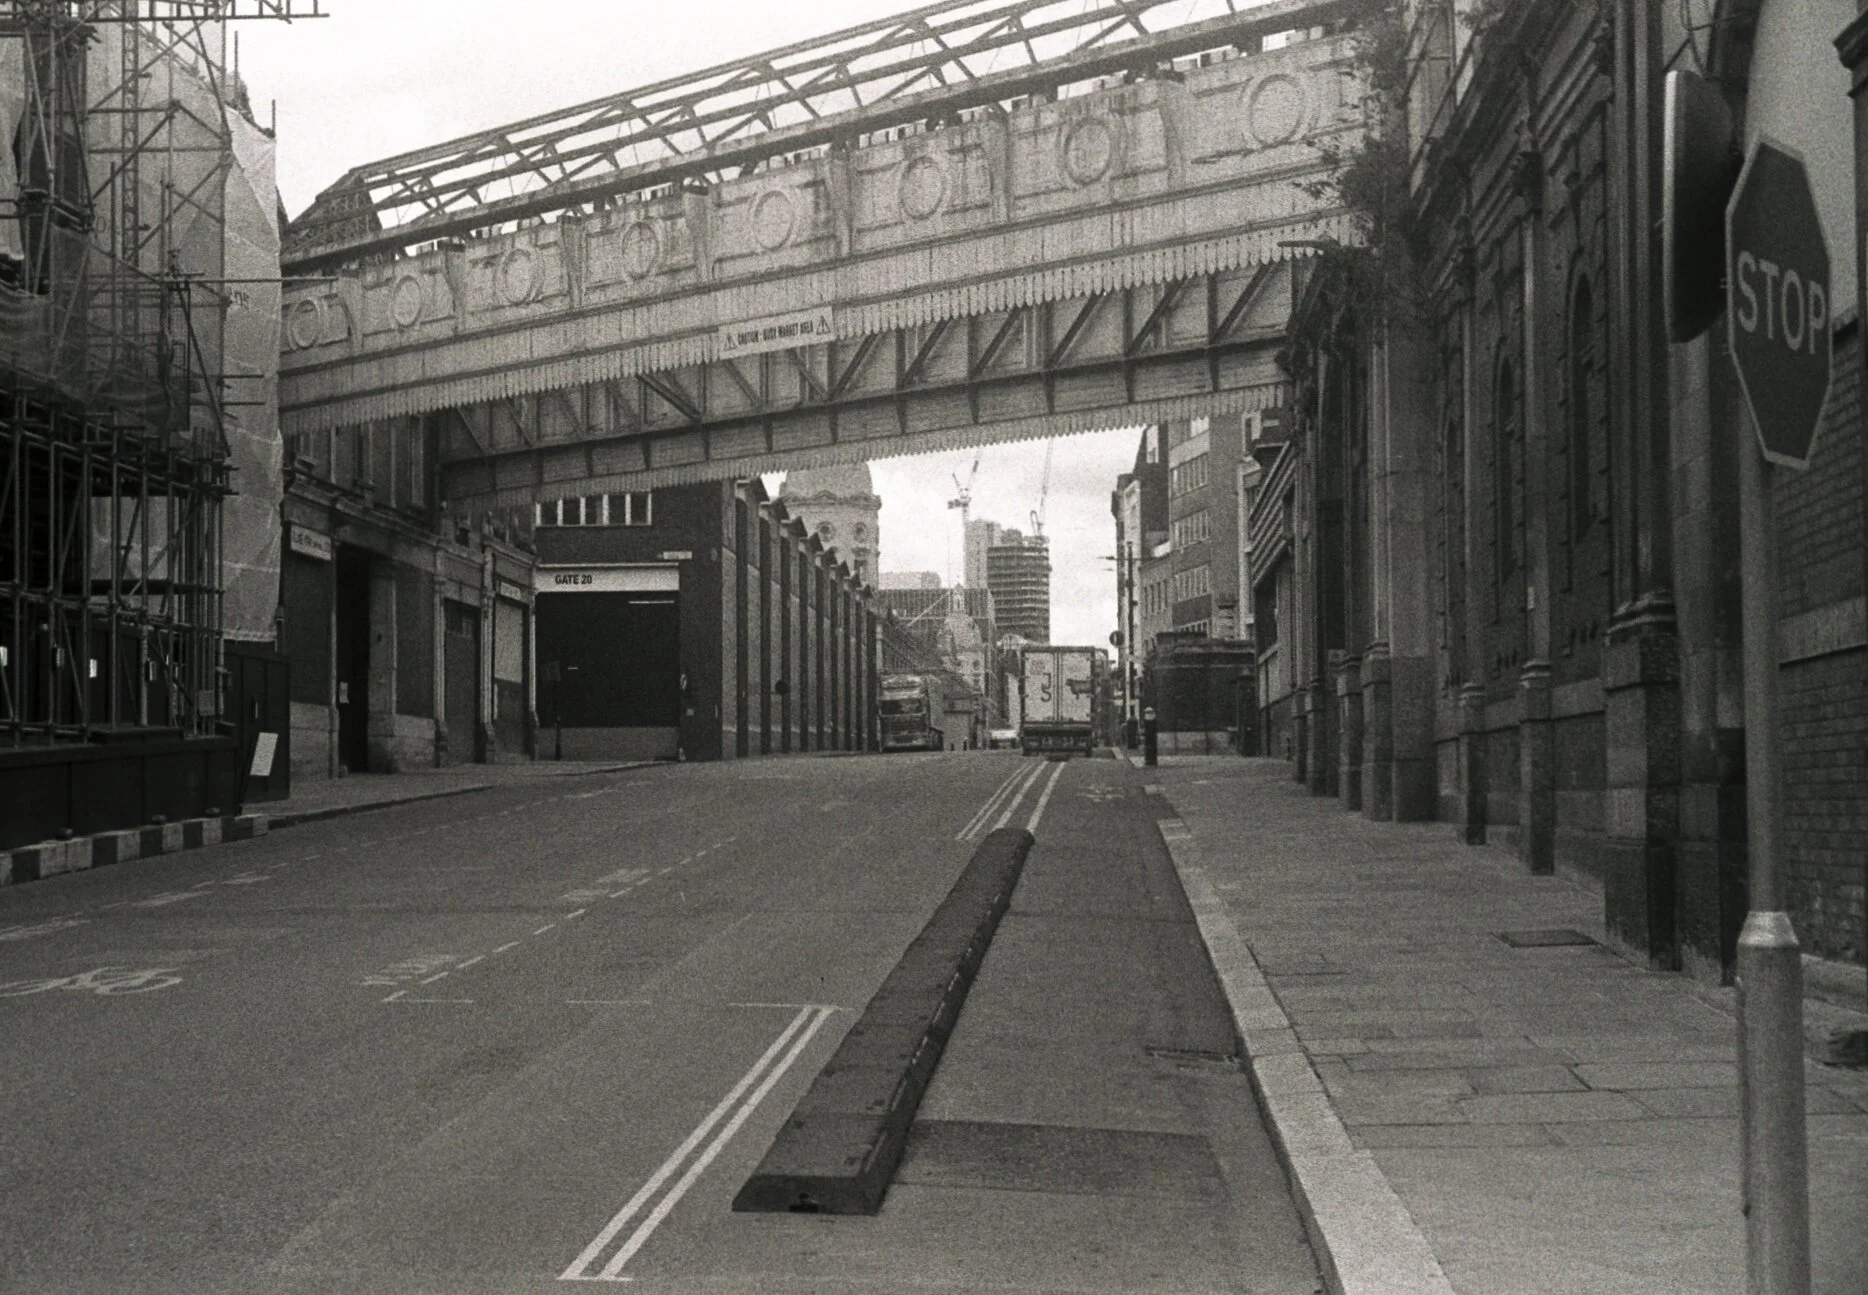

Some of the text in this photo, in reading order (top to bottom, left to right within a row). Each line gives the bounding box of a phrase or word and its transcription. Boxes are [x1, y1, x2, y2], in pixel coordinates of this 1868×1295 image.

[1737, 250, 1826, 355] STOP
[738, 331, 758, 345] CAUTION
[778, 323, 798, 338] MARKET
[800, 320, 813, 334] AREA
[555, 574, 592, 585] GATE 20
